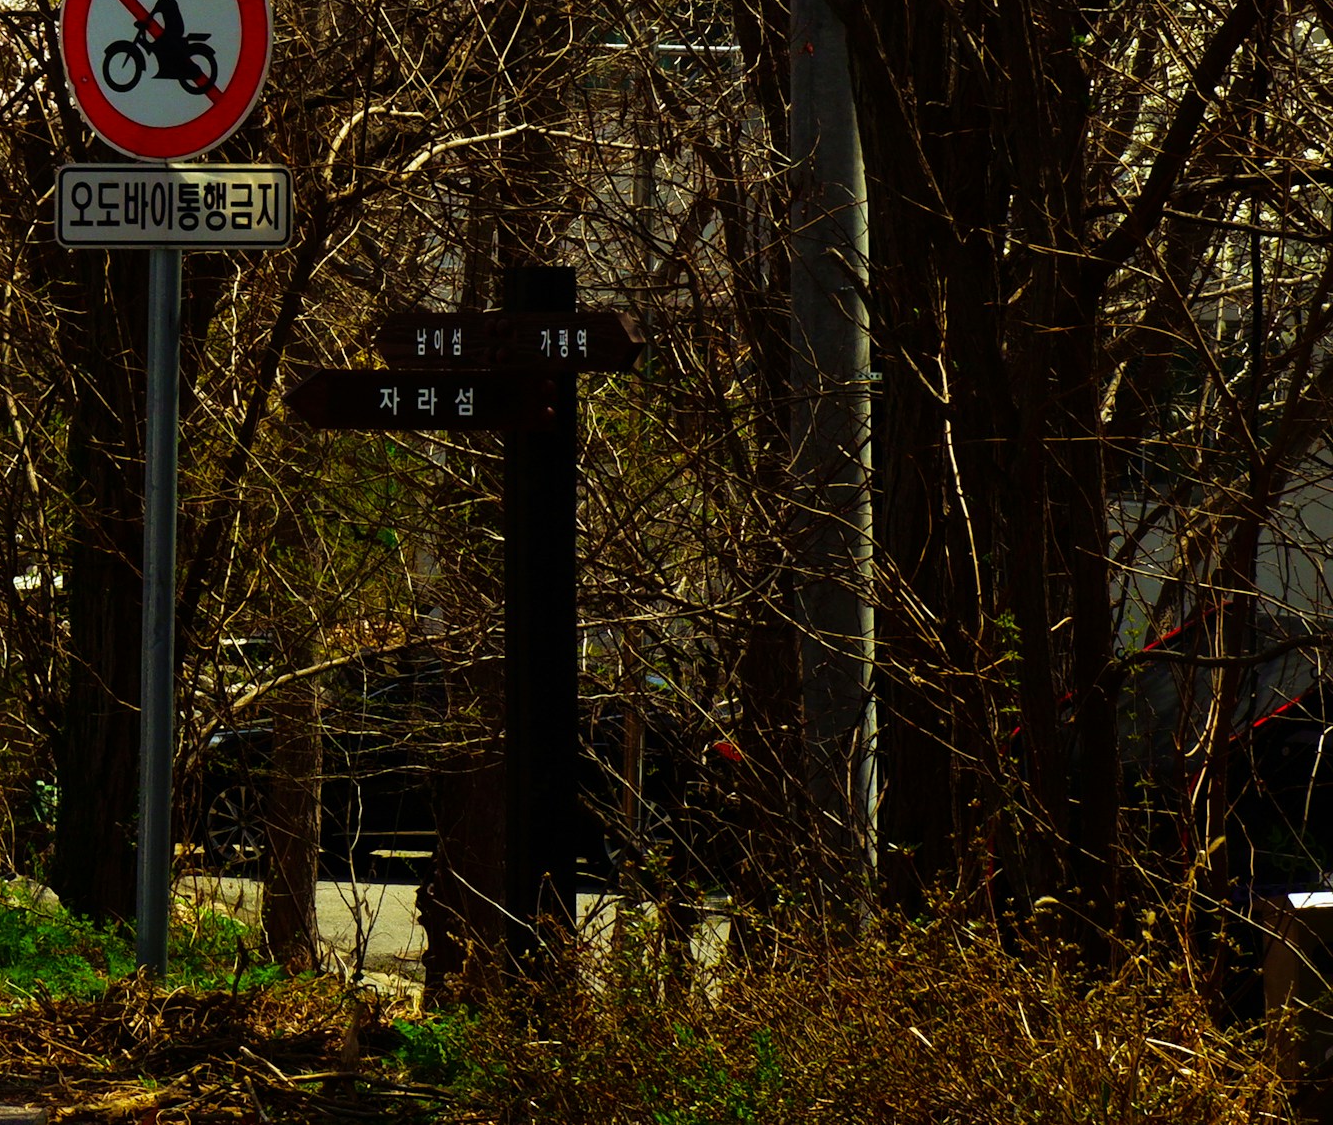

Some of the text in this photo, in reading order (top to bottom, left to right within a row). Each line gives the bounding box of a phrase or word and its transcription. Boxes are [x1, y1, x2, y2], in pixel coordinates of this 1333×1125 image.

[69, 181, 280, 231] 오도바이통행금지
[417, 328, 587, 358] 남이섬 가평역
[379, 387, 474, 416] 자라섬
